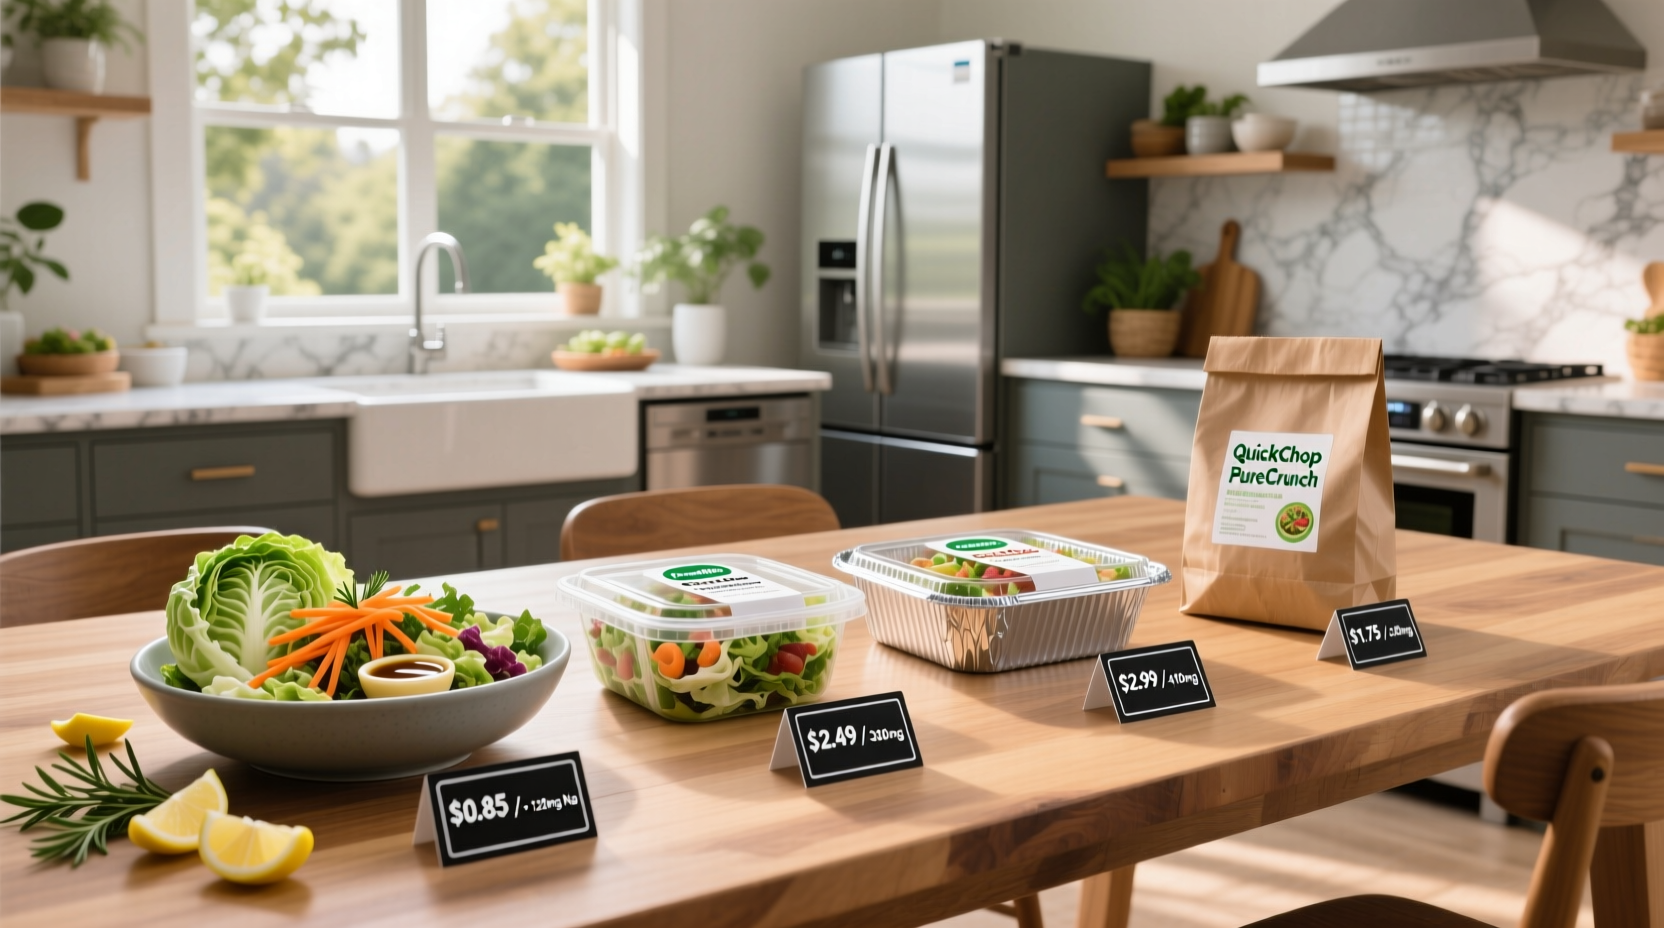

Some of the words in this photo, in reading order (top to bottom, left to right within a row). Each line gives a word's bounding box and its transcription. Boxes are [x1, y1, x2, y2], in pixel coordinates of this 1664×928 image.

[1233, 443, 1322, 468] QuickChop
[1229, 466, 1318, 488] PureCrunch
[1349, 624, 1381, 645] $1.75
[1119, 669, 1158, 694] $2.99
[808, 725, 856, 753] $2.49
[449, 792, 509, 827] $0.85
